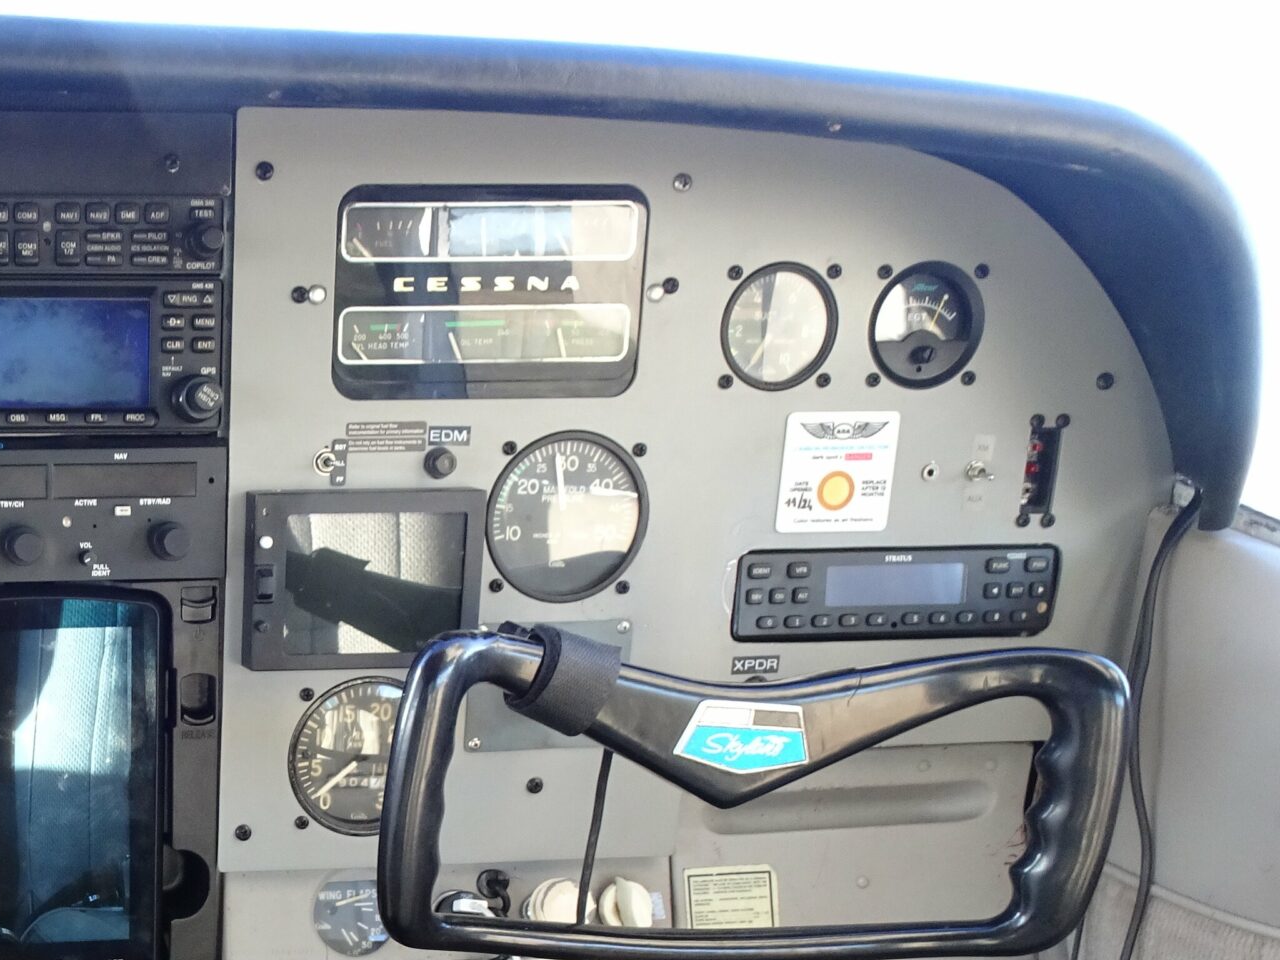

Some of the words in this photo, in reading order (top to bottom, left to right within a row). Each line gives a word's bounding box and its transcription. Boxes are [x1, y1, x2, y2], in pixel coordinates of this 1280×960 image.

[17, 211, 37, 219] COM3
[186, 262, 215, 270] COPILOT
[393, 276, 580, 292] CESSNA
[195, 318, 215, 326] MENU
[368, 341, 388, 350] HEAD
[389, 341, 410, 349] TEMP
[474, 338, 493, 346] TEMP
[201, 367, 216, 375] GPS
[10, 414, 25, 422] OBS
[49, 414, 66, 422] MSG
[90, 414, 103, 422] FPL
[126, 414, 145, 422] PROC
[429, 429, 468, 442] EDM
[517, 478, 539, 494] 20
[505, 525, 521, 541] 10
[733, 658, 778, 671] XPDR
[371, 703, 392, 720] 20
[311, 760, 321, 776] 5
[319, 890, 342, 900] WING
[346, 889, 377, 899] FLAPS
